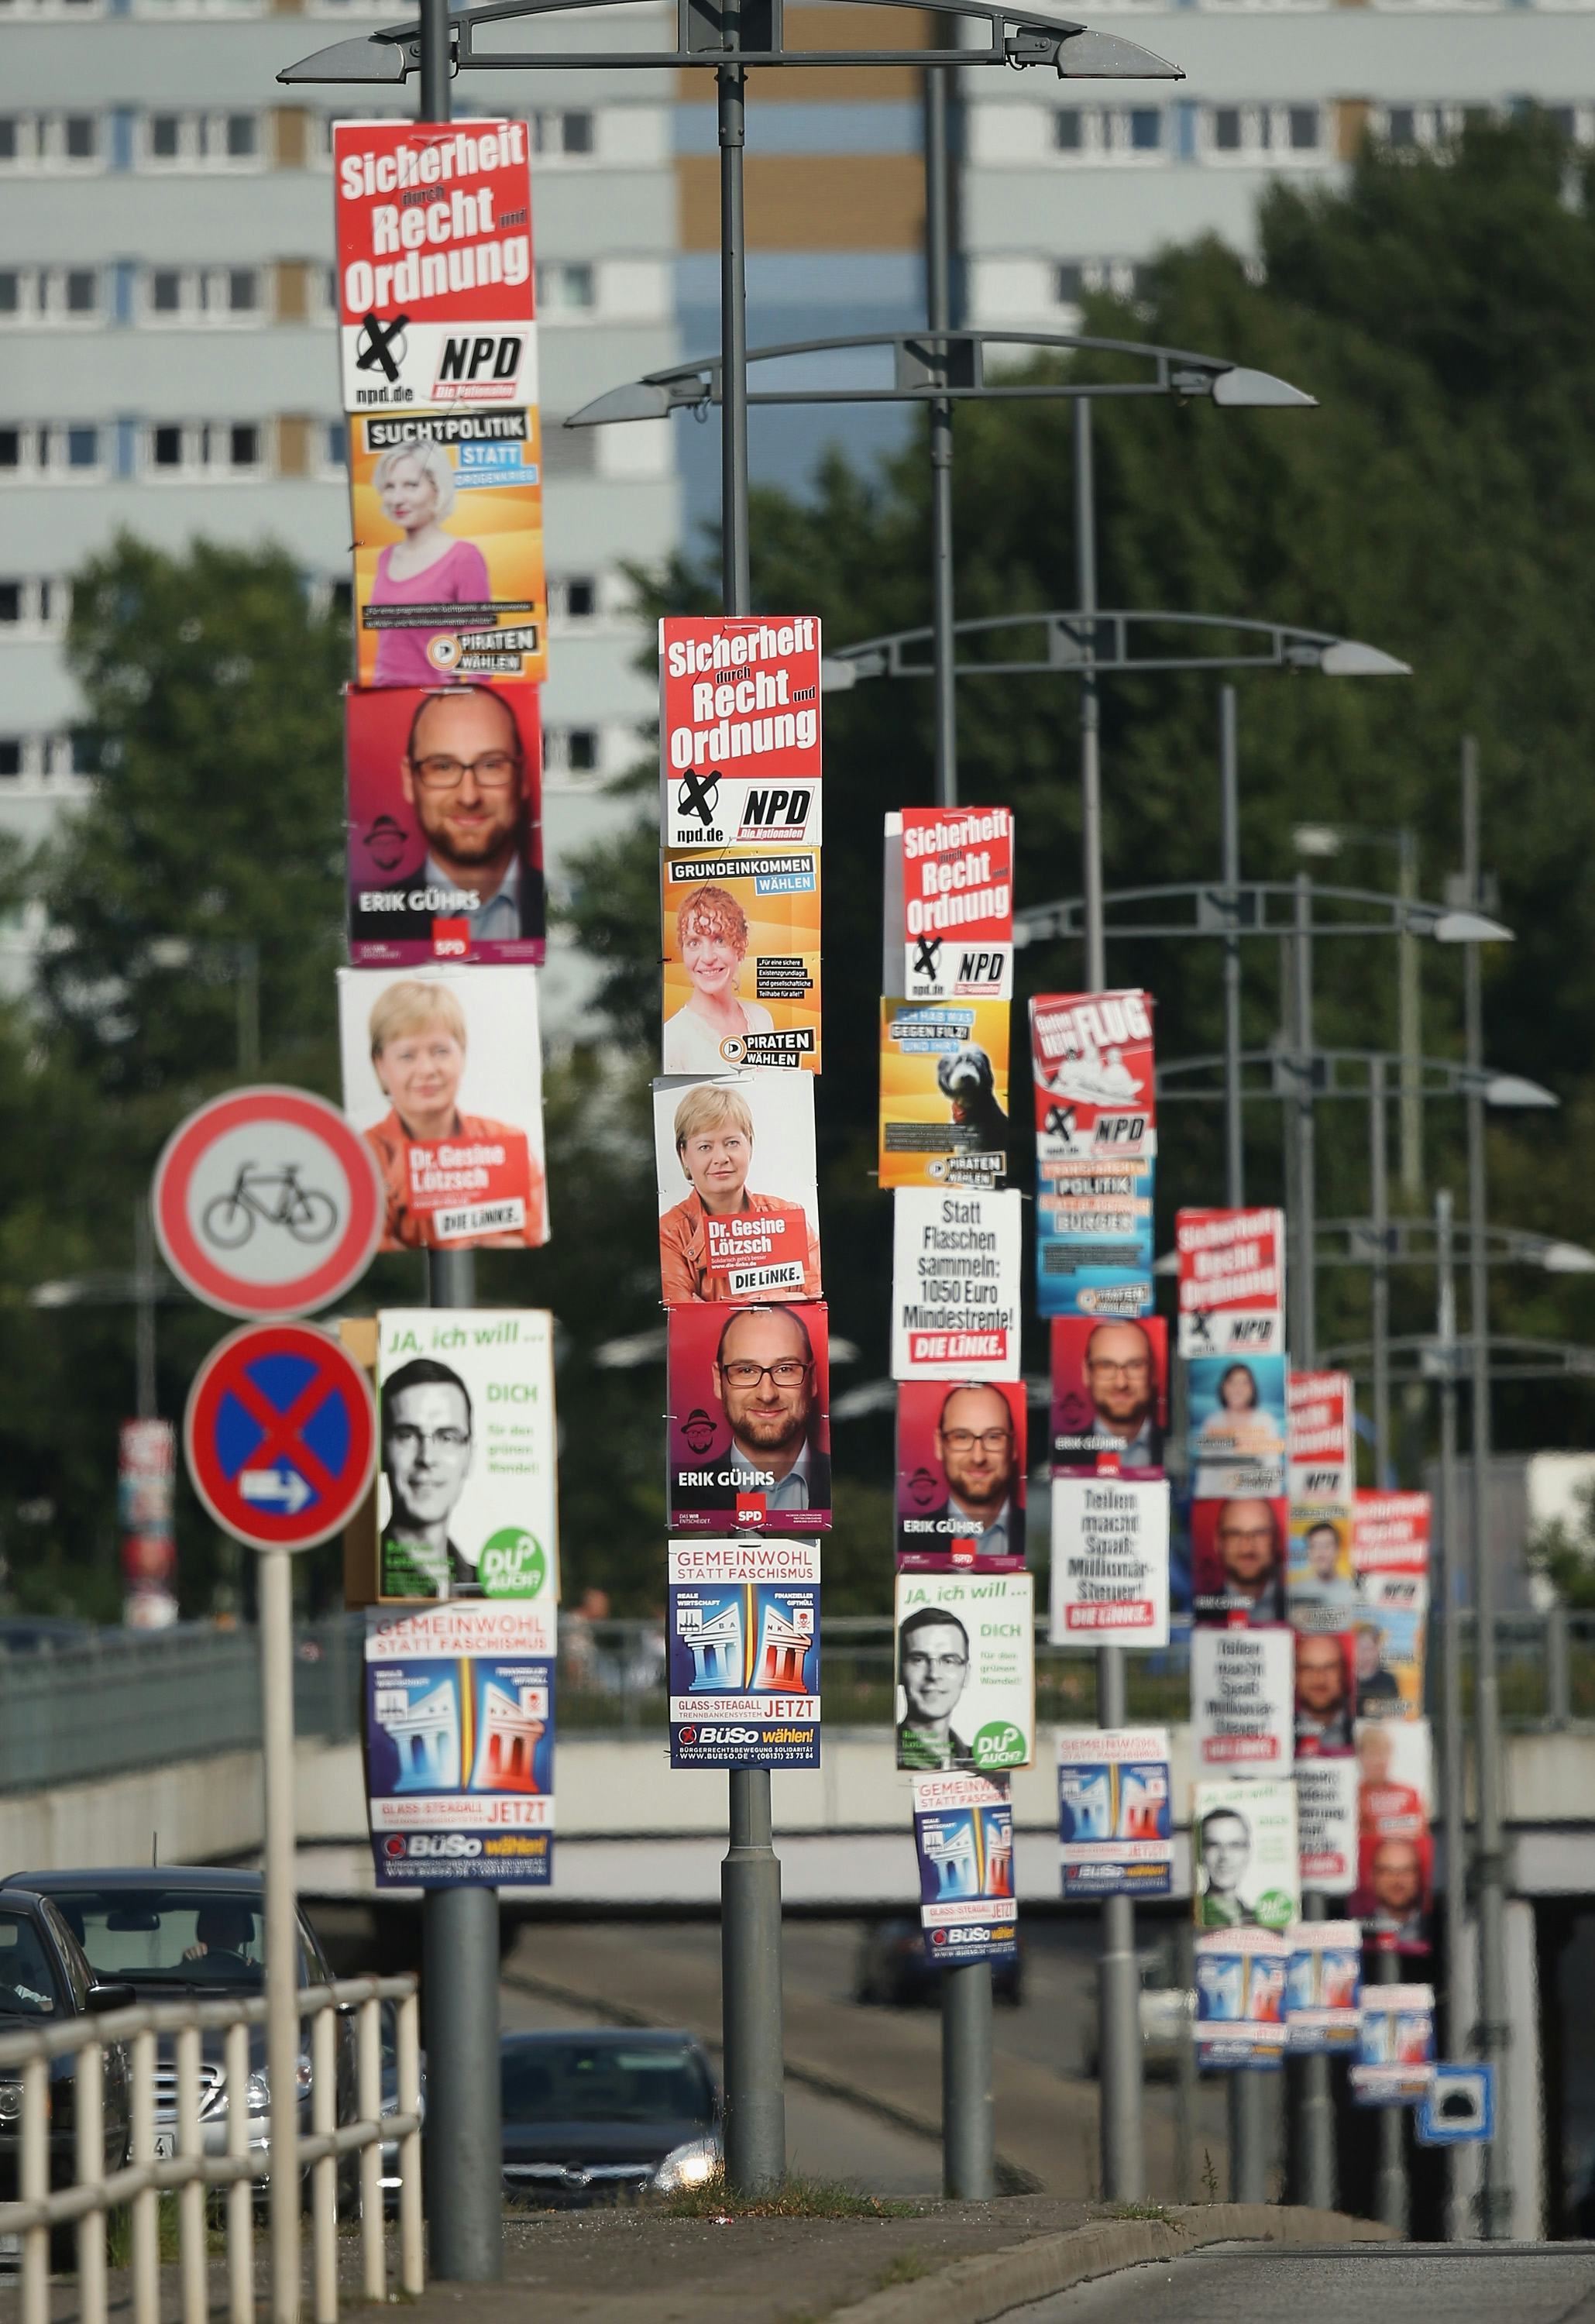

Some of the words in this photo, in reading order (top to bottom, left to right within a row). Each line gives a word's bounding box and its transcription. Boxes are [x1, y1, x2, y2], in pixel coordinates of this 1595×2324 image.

[341, 123, 526, 200] Sicherheit
[372, 187, 496, 256] Recht
[345, 235, 530, 314] Ordnung
[439, 337, 522, 380] NPD
[356, 387, 414, 405] npd.de
[370, 416, 524, 445] SUCHTPOLITIK
[462, 446, 517, 465] STATT
[461, 629, 535, 651] PIRATEN
[668, 618, 815, 678] Sicherheit
[716, 665, 751, 685] durch
[693, 669, 790, 724] Recht
[792, 686, 816, 703] und
[670, 708, 817, 769] Ordnung
[742, 789, 811, 826] NPD
[677, 827, 724, 844] npd.de
[741, 828, 757, 840] Die
[757, 827, 803, 840] Nationalen
[903, 809, 1009, 859] Sicherheit
[675, 858, 811, 878] GRUNDEINKOMMEN
[922, 851, 992, 896] Recht
[759, 876, 811, 892] WÄHLEN
[359, 891, 407, 913] ERIK
[407, 885, 482, 912] GÜHRS
[906, 884, 1009, 936] Ordnung
[434, 939, 466, 956] SPD
[959, 952, 1005, 982] NPD
[747, 1033, 810, 1049] PIRATEN
[892, 1025, 936, 1039] GEGEN
[747, 1052, 796, 1066] WÄHLEN
[1096, 1118, 1144, 1142] NPD
[409, 1147, 438, 1171] Dr.
[438, 1143, 506, 1170] Gesine
[949, 1157, 1001, 1171] PIRATEN
[411, 1167, 490, 1193] Lötzsch
[1059, 1177, 1129, 1195] POLITIK
[942, 1200, 981, 1223] Statt
[443, 1215, 467, 1232] DIE
[708, 1222, 730, 1239] Dr.
[731, 1217, 785, 1237] Gesine
[710, 1236, 772, 1257] Lötzsch
[923, 1226, 996, 1251] Flaschen
[711, 1261, 757, 1270] www.die-linke.de
[917, 1256, 1000, 1277] sammeln:
[735, 1273, 756, 1289] DIE
[922, 1280, 961, 1303] 1050
[964, 1281, 998, 1304] Euro
[903, 1305, 1013, 1331] Mindestrente!
[388, 1328, 425, 1354] JA,
[431, 1326, 467, 1350] ich
[473, 1320, 520, 1346] will
[914, 1336, 947, 1359] DIE
[486, 1383, 539, 1404] DICH
[678, 1471, 715, 1487] ERIK
[717, 1468, 775, 1487] GÜHRS
[738, 1511, 762, 1521] SPD
[903, 1519, 935, 1533] ERIK
[936, 1518, 985, 1534] GÜHRS
[678, 1551, 813, 1566] GEMEINWOHL
[678, 1569, 724, 1579] STATT
[729, 1568, 813, 1579] FASCHISMUS
[904, 1588, 931, 1604] JA,
[937, 1585, 964, 1602] ich
[971, 1581, 1007, 1600] will
[375, 1614, 544, 1636] GEMEINWOHL
[980, 1624, 1022, 1637] DICH
[377, 1637, 431, 1653] STATT
[440, 1635, 546, 1651] FASCHISMUS
[679, 1700, 761, 1710] GLASS-STEAGALL
[764, 1700, 814, 1718] JETZT
[699, 1727, 759, 1744] BüSo
[762, 1728, 814, 1744] wählen!
[980, 1750, 1023, 1765] AUCH?
[921, 1796, 956, 1807] STATT
[489, 1801, 547, 1824] JETZT
[408, 1834, 483, 1858] BüSo
[992, 1903, 1013, 1919] JETZT
[948, 1927, 991, 1944] BüSo
